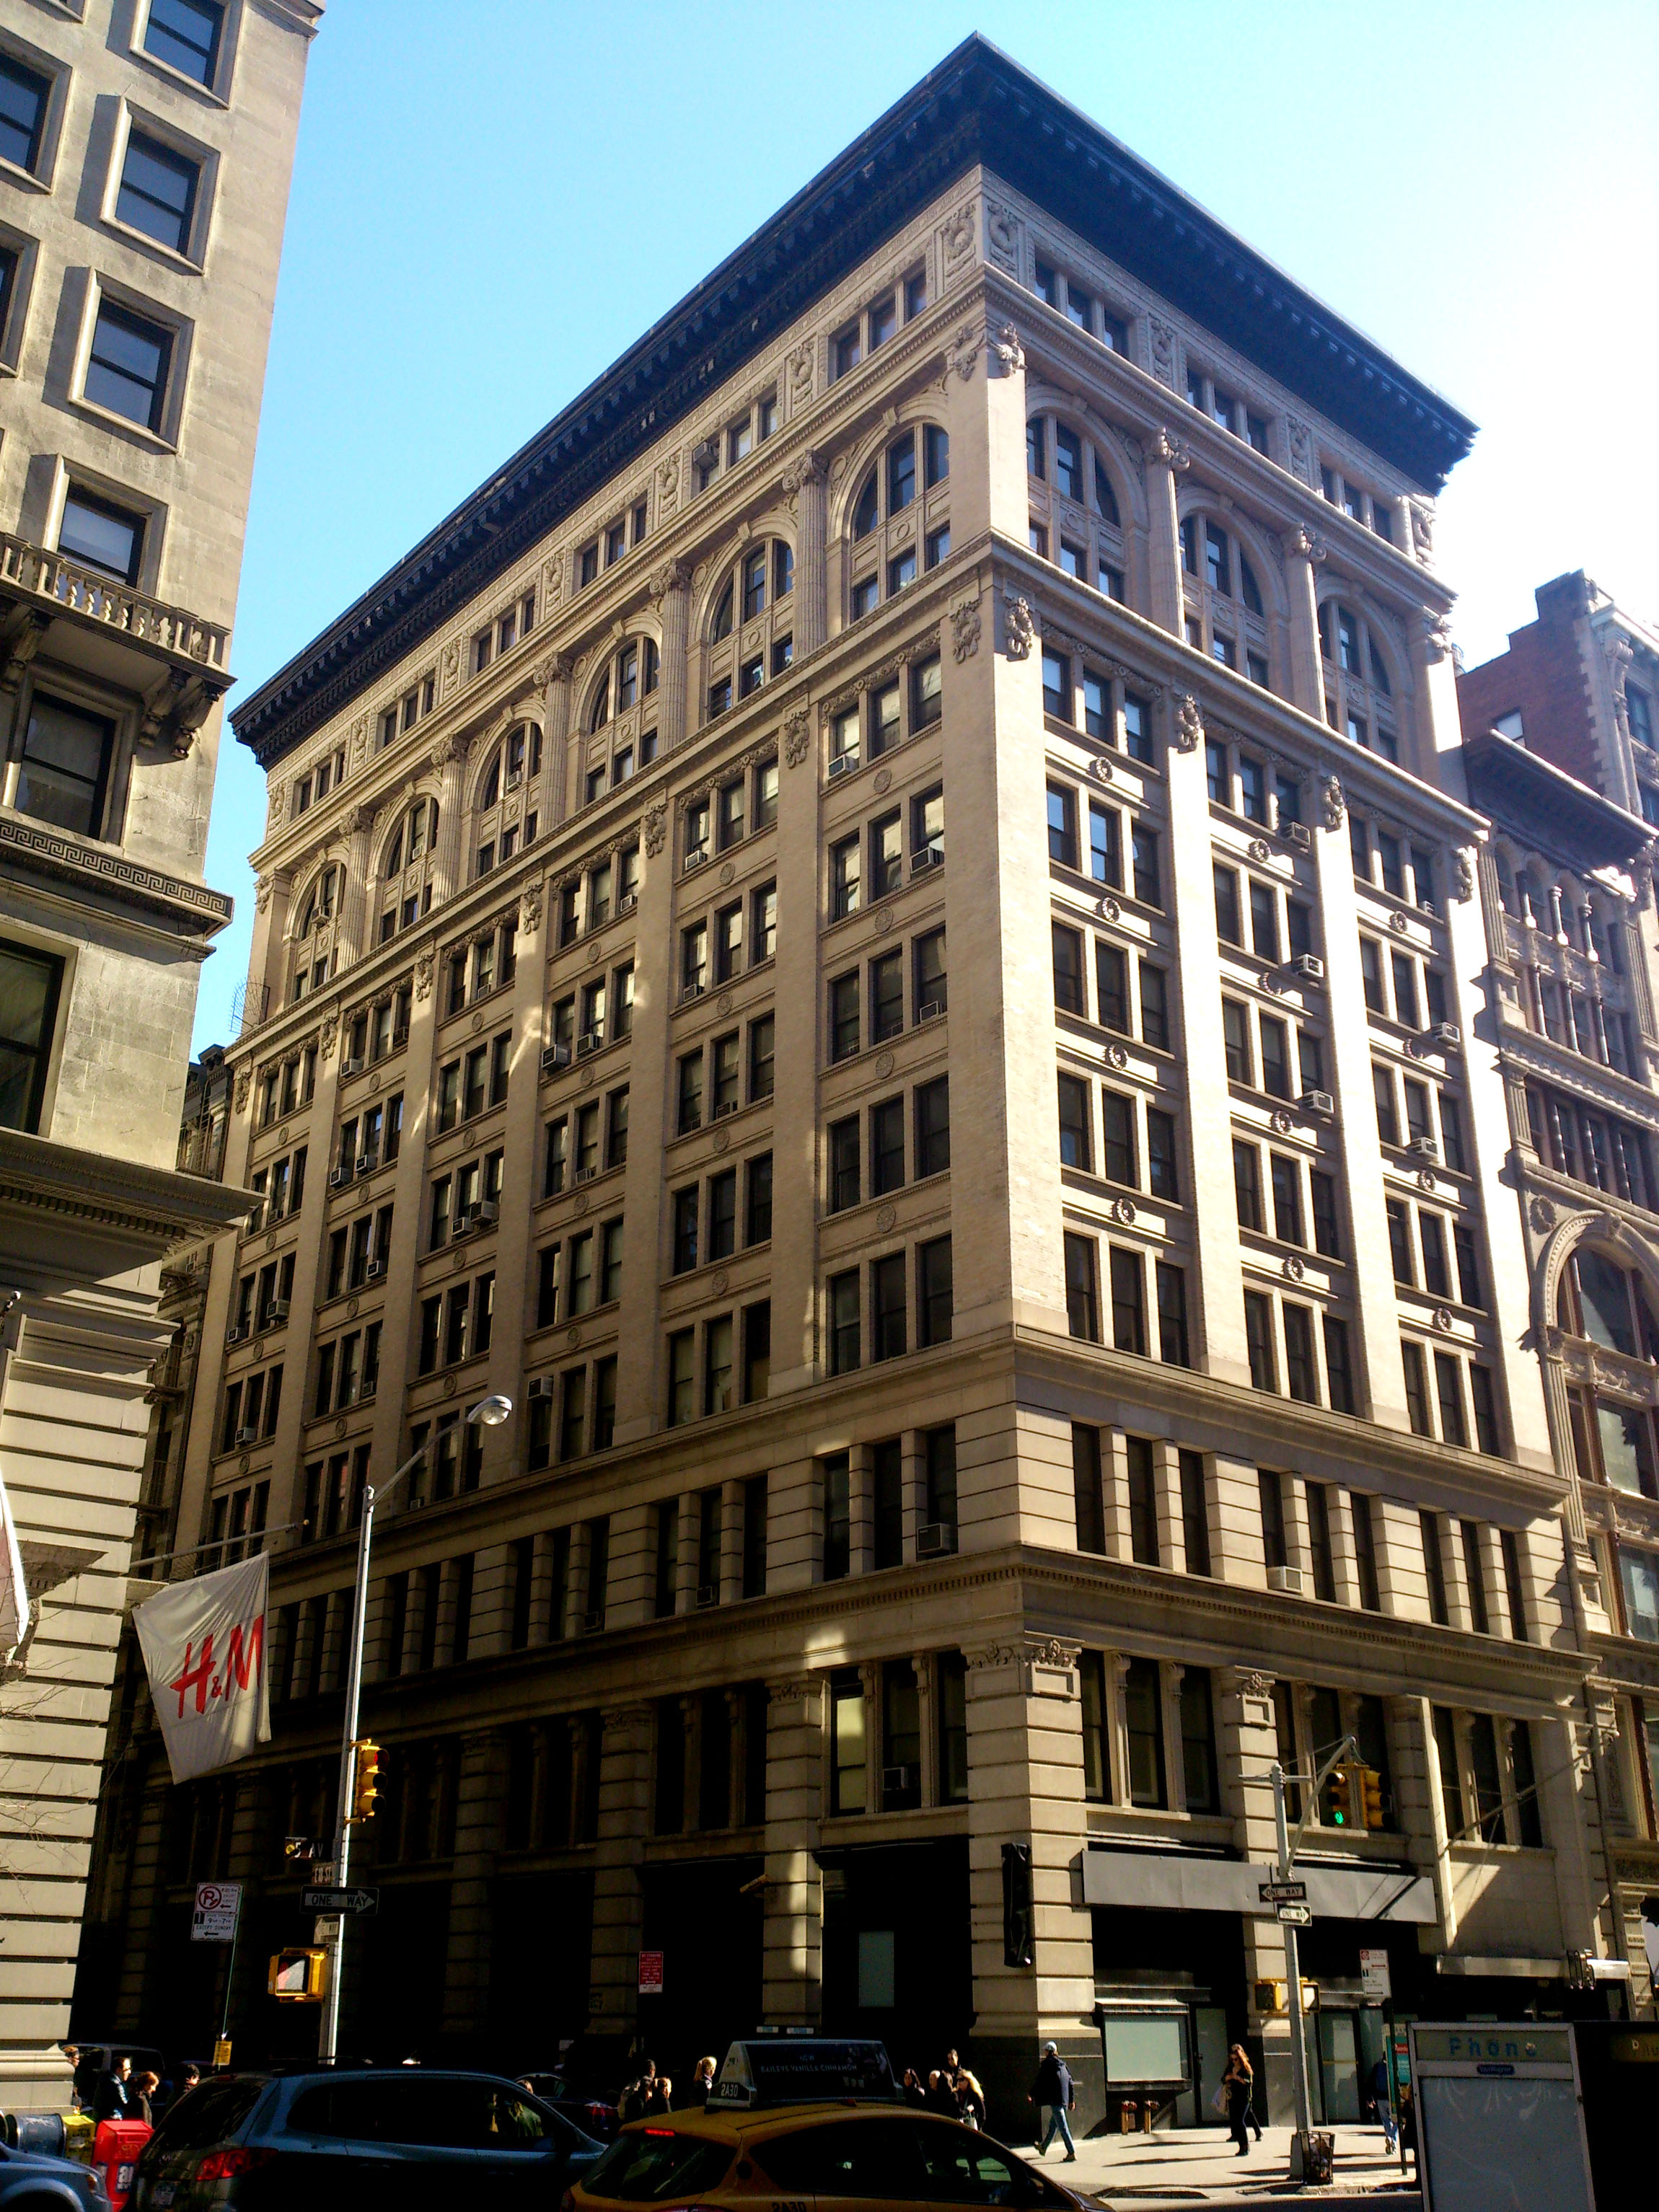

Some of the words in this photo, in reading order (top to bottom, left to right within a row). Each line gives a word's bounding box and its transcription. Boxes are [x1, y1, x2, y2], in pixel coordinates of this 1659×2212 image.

[170, 1614, 264, 1719] H&M
[294, 1841, 302, 1859] 5
[308, 1842, 324, 1859] AV
[312, 1895, 332, 1905] ONE
[347, 1896, 369, 1906] WAY
[721, 2083, 739, 2097] 2A30
